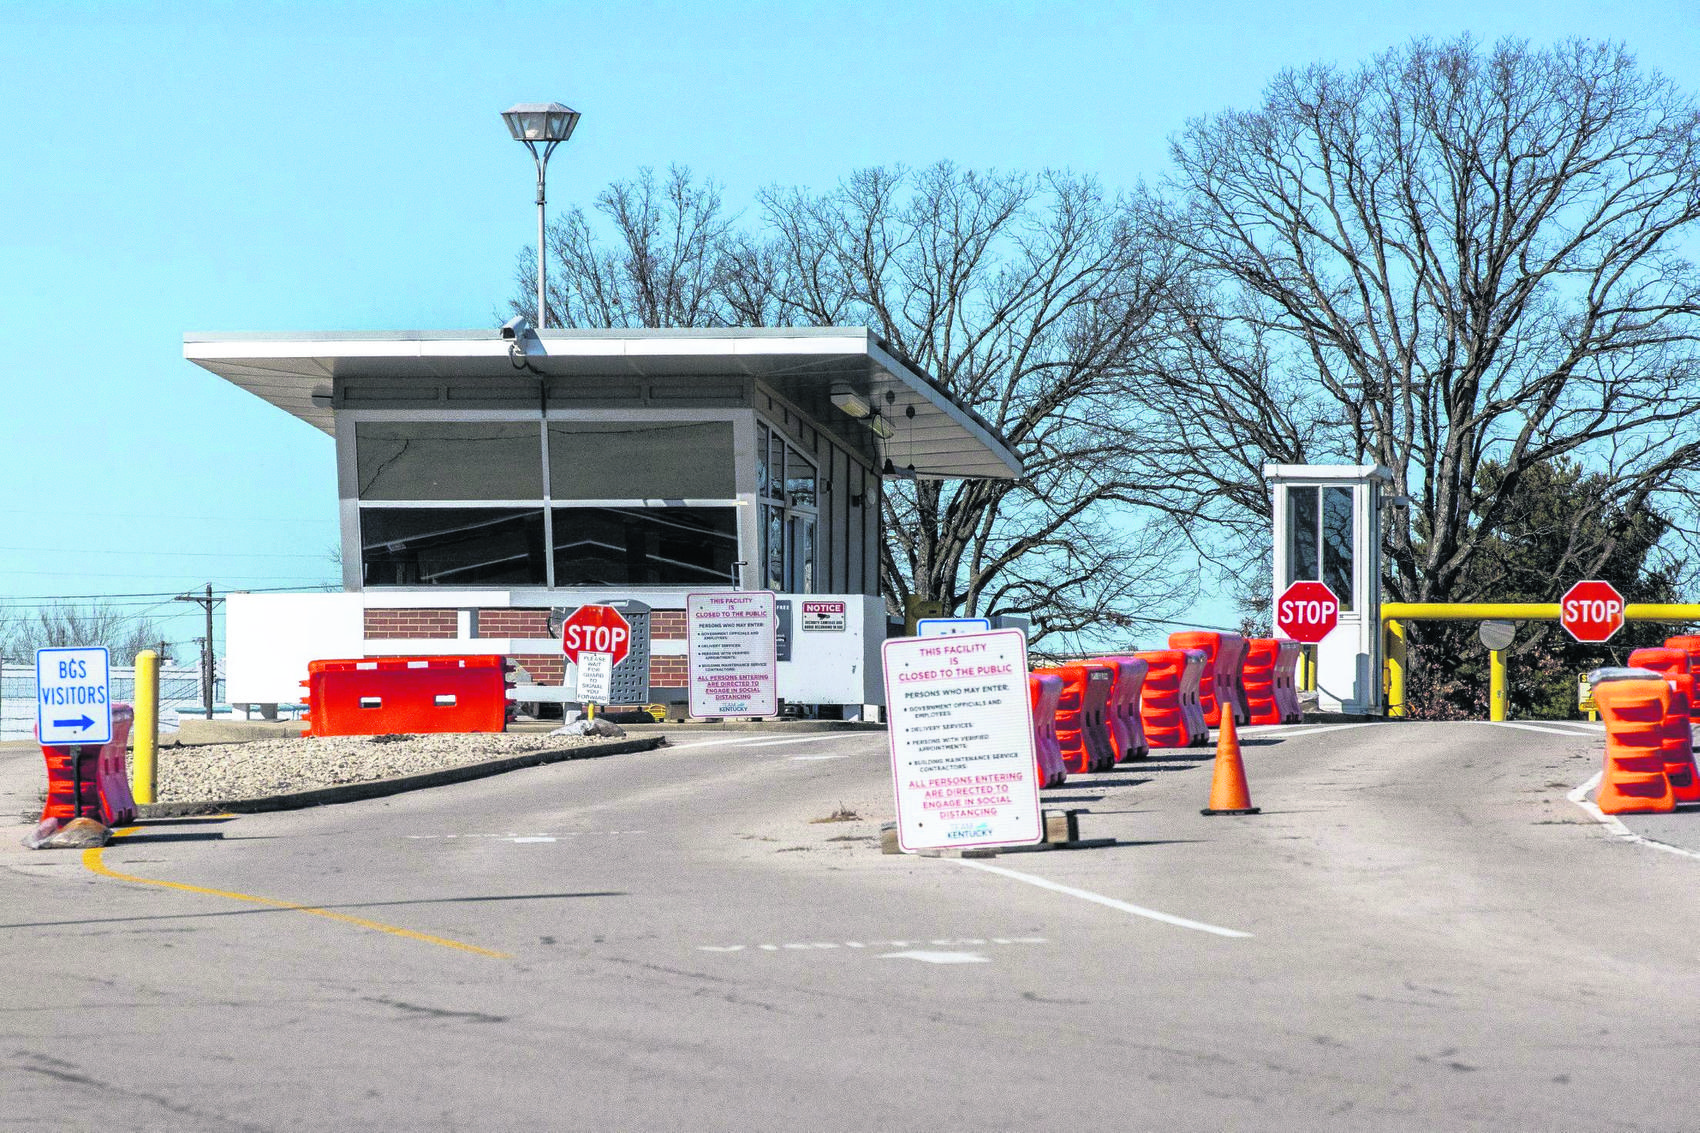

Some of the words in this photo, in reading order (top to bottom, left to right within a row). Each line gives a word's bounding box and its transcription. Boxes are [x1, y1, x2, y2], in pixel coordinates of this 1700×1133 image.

[1280, 600, 1335, 624] STOP
[1566, 600, 1620, 623] STOP
[566, 624, 626, 651] STOP
[920, 648, 940, 657] THIS
[944, 644, 987, 654] FACILITY
[59, 660, 87, 678] BGS
[899, 671, 937, 681] CLOSED
[940, 669, 953, 678] TO
[956, 668, 974, 676] THE
[977, 664, 1012, 673] PUBLIC
[42, 686, 105, 705] VISITORS
[905, 690, 940, 699] PERSONS
[954, 700, 986, 708] OFFICIALS
[919, 744, 967, 752] APPOINTMENTS
[945, 754, 990, 763] MAINTENANCE
[920, 764, 966, 772] CONTRACTORS
[929, 776, 972, 787] PERSONS
[976, 772, 1023, 783] ENTERING
[925, 789, 944, 798] ARE
[946, 786, 993, 796] DIRECTED
[923, 800, 961, 809] ENGAGE
[977, 796, 1012, 805] SOCIAL
[940, 808, 997, 819] DISTANCING
[948, 829, 992, 838] KENTUCKY
